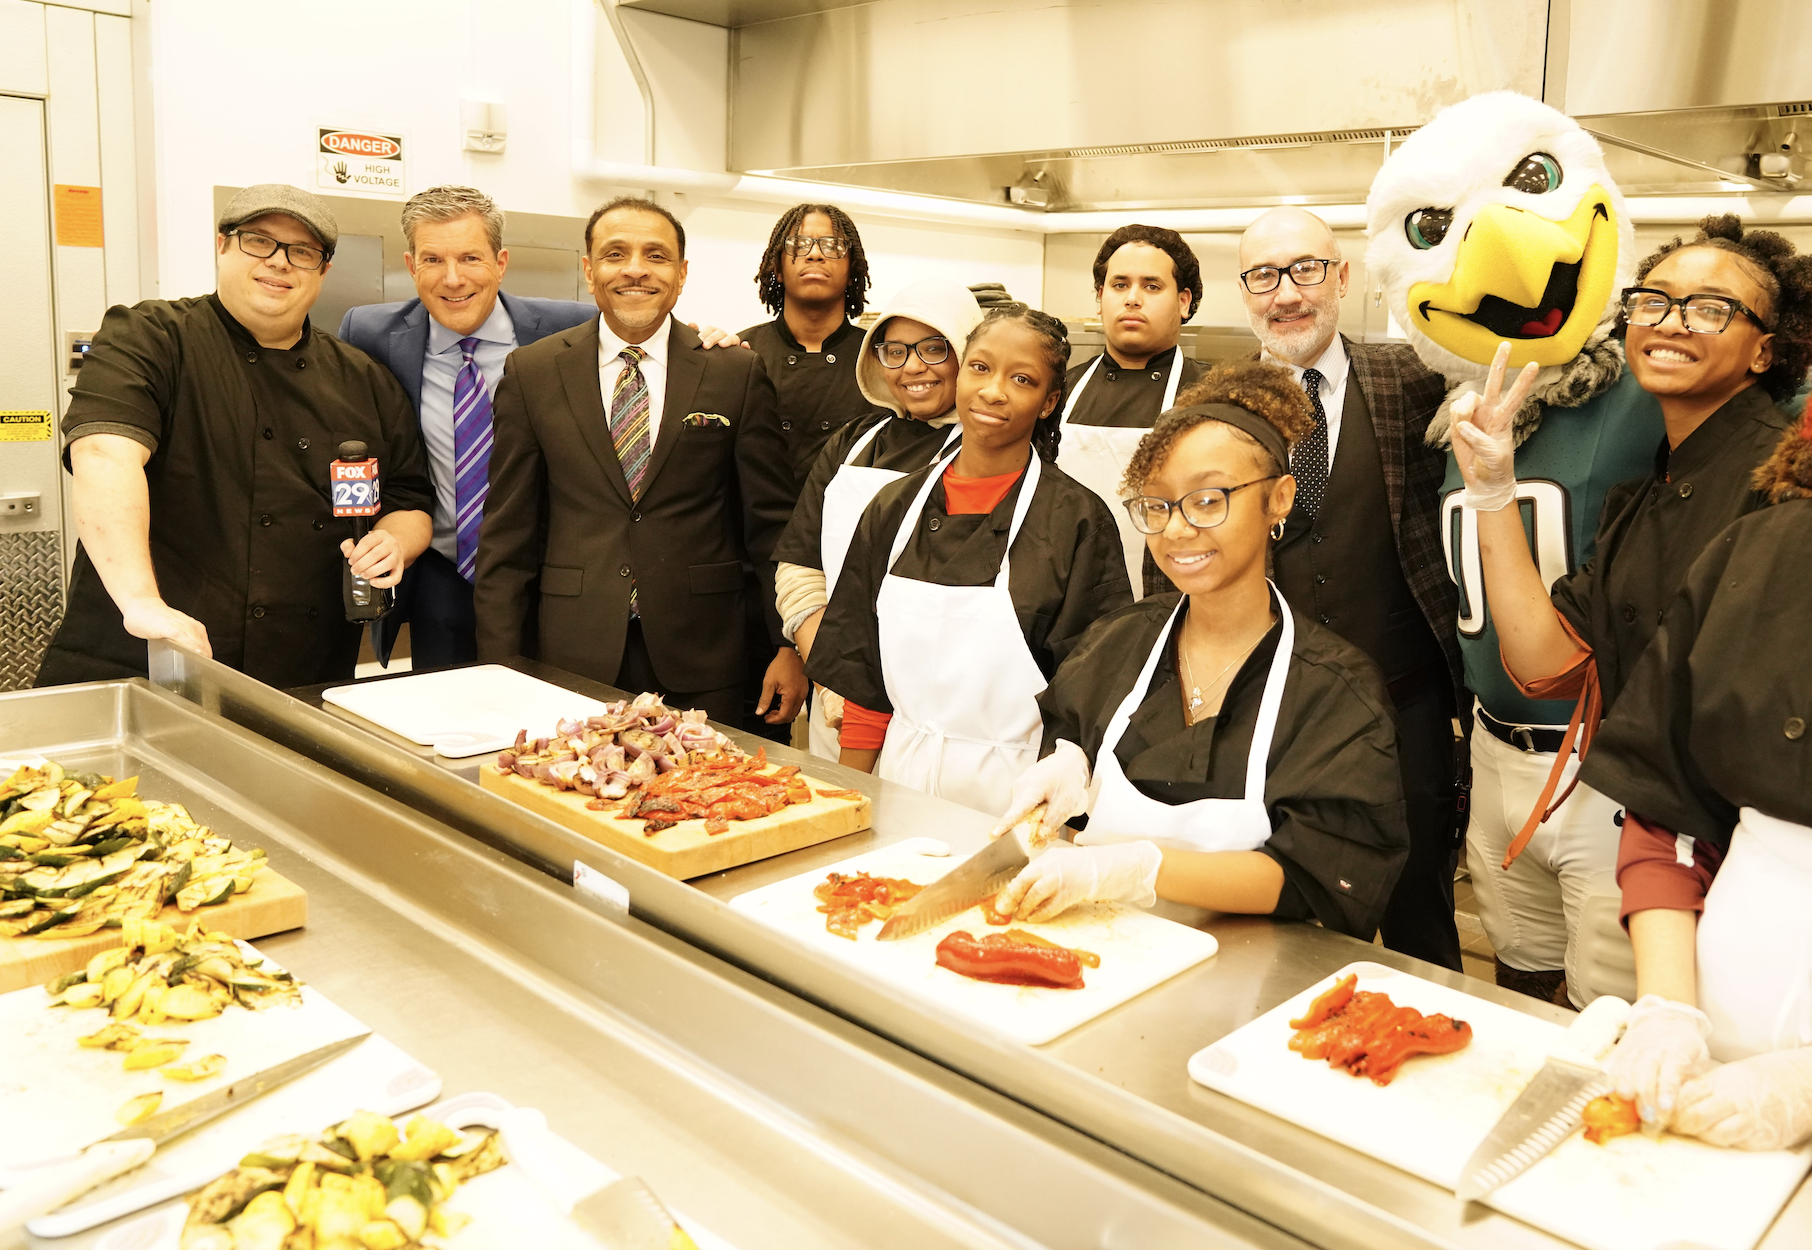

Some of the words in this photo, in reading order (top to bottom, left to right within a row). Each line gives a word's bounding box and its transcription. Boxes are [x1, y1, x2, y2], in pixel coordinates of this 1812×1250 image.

[329, 136, 392, 154] DANGER
[365, 164, 390, 174] HIGH
[354, 175, 400, 187] VOLTAGE
[337, 466, 366, 479] FOX
[335, 482, 370, 504] 29
